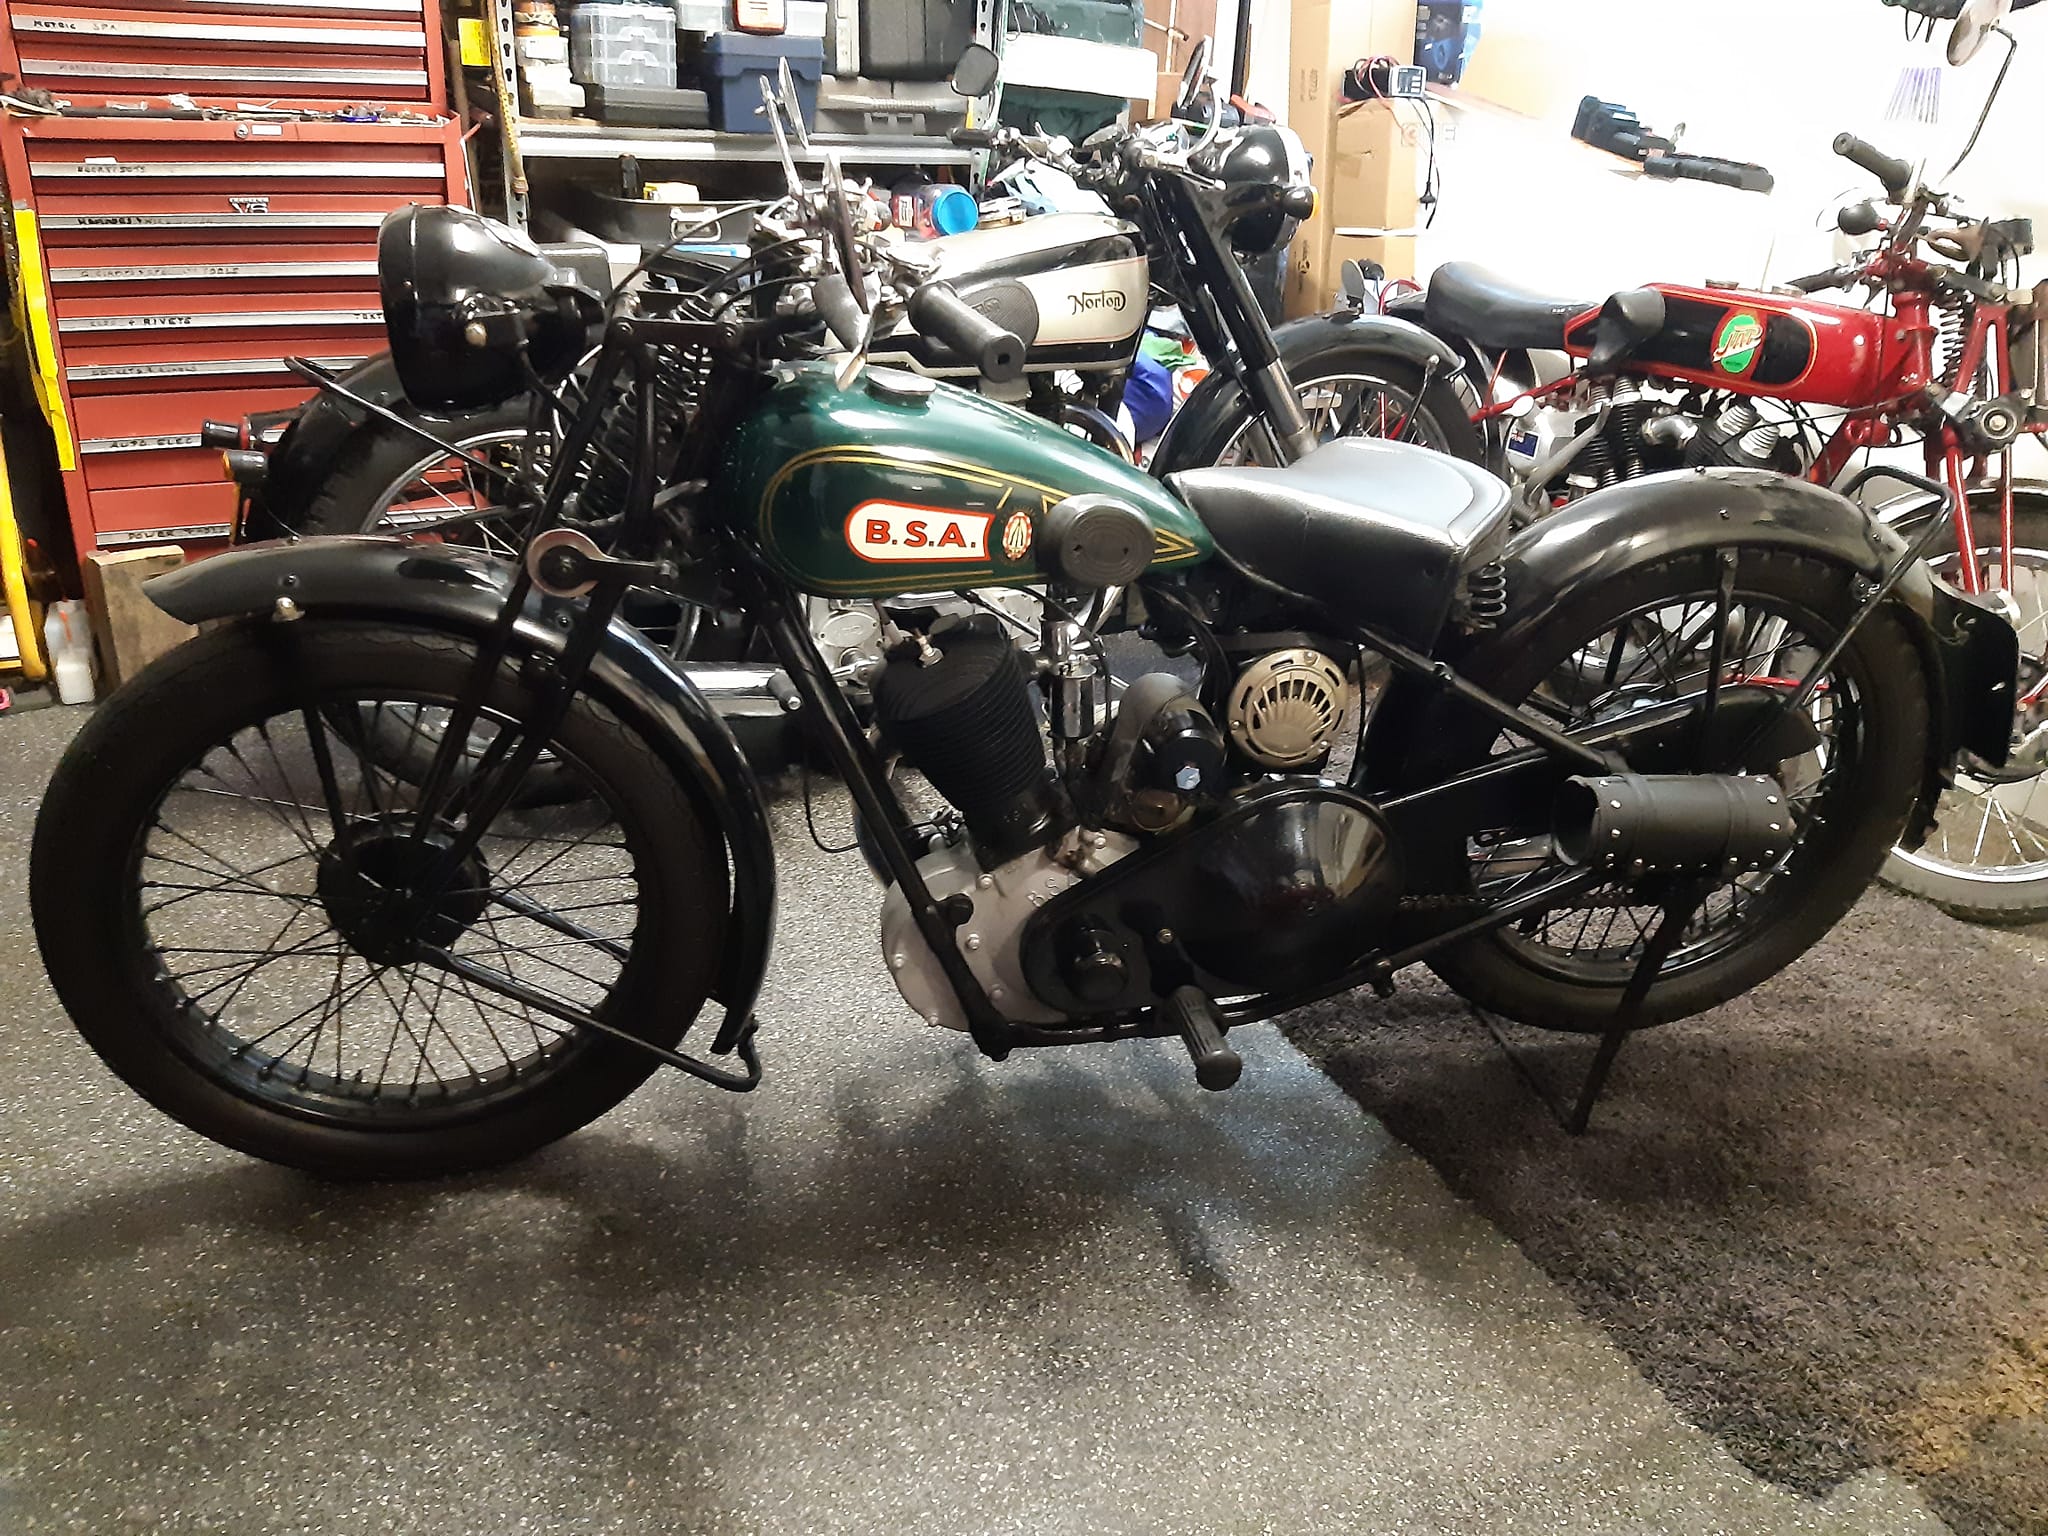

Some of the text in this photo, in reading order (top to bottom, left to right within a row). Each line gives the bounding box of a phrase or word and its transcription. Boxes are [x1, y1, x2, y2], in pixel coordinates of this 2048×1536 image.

[1067, 290, 1126, 315] Norton
[143, 317, 192, 326] RIVETS
[865, 519, 976, 549] B.S.A.
